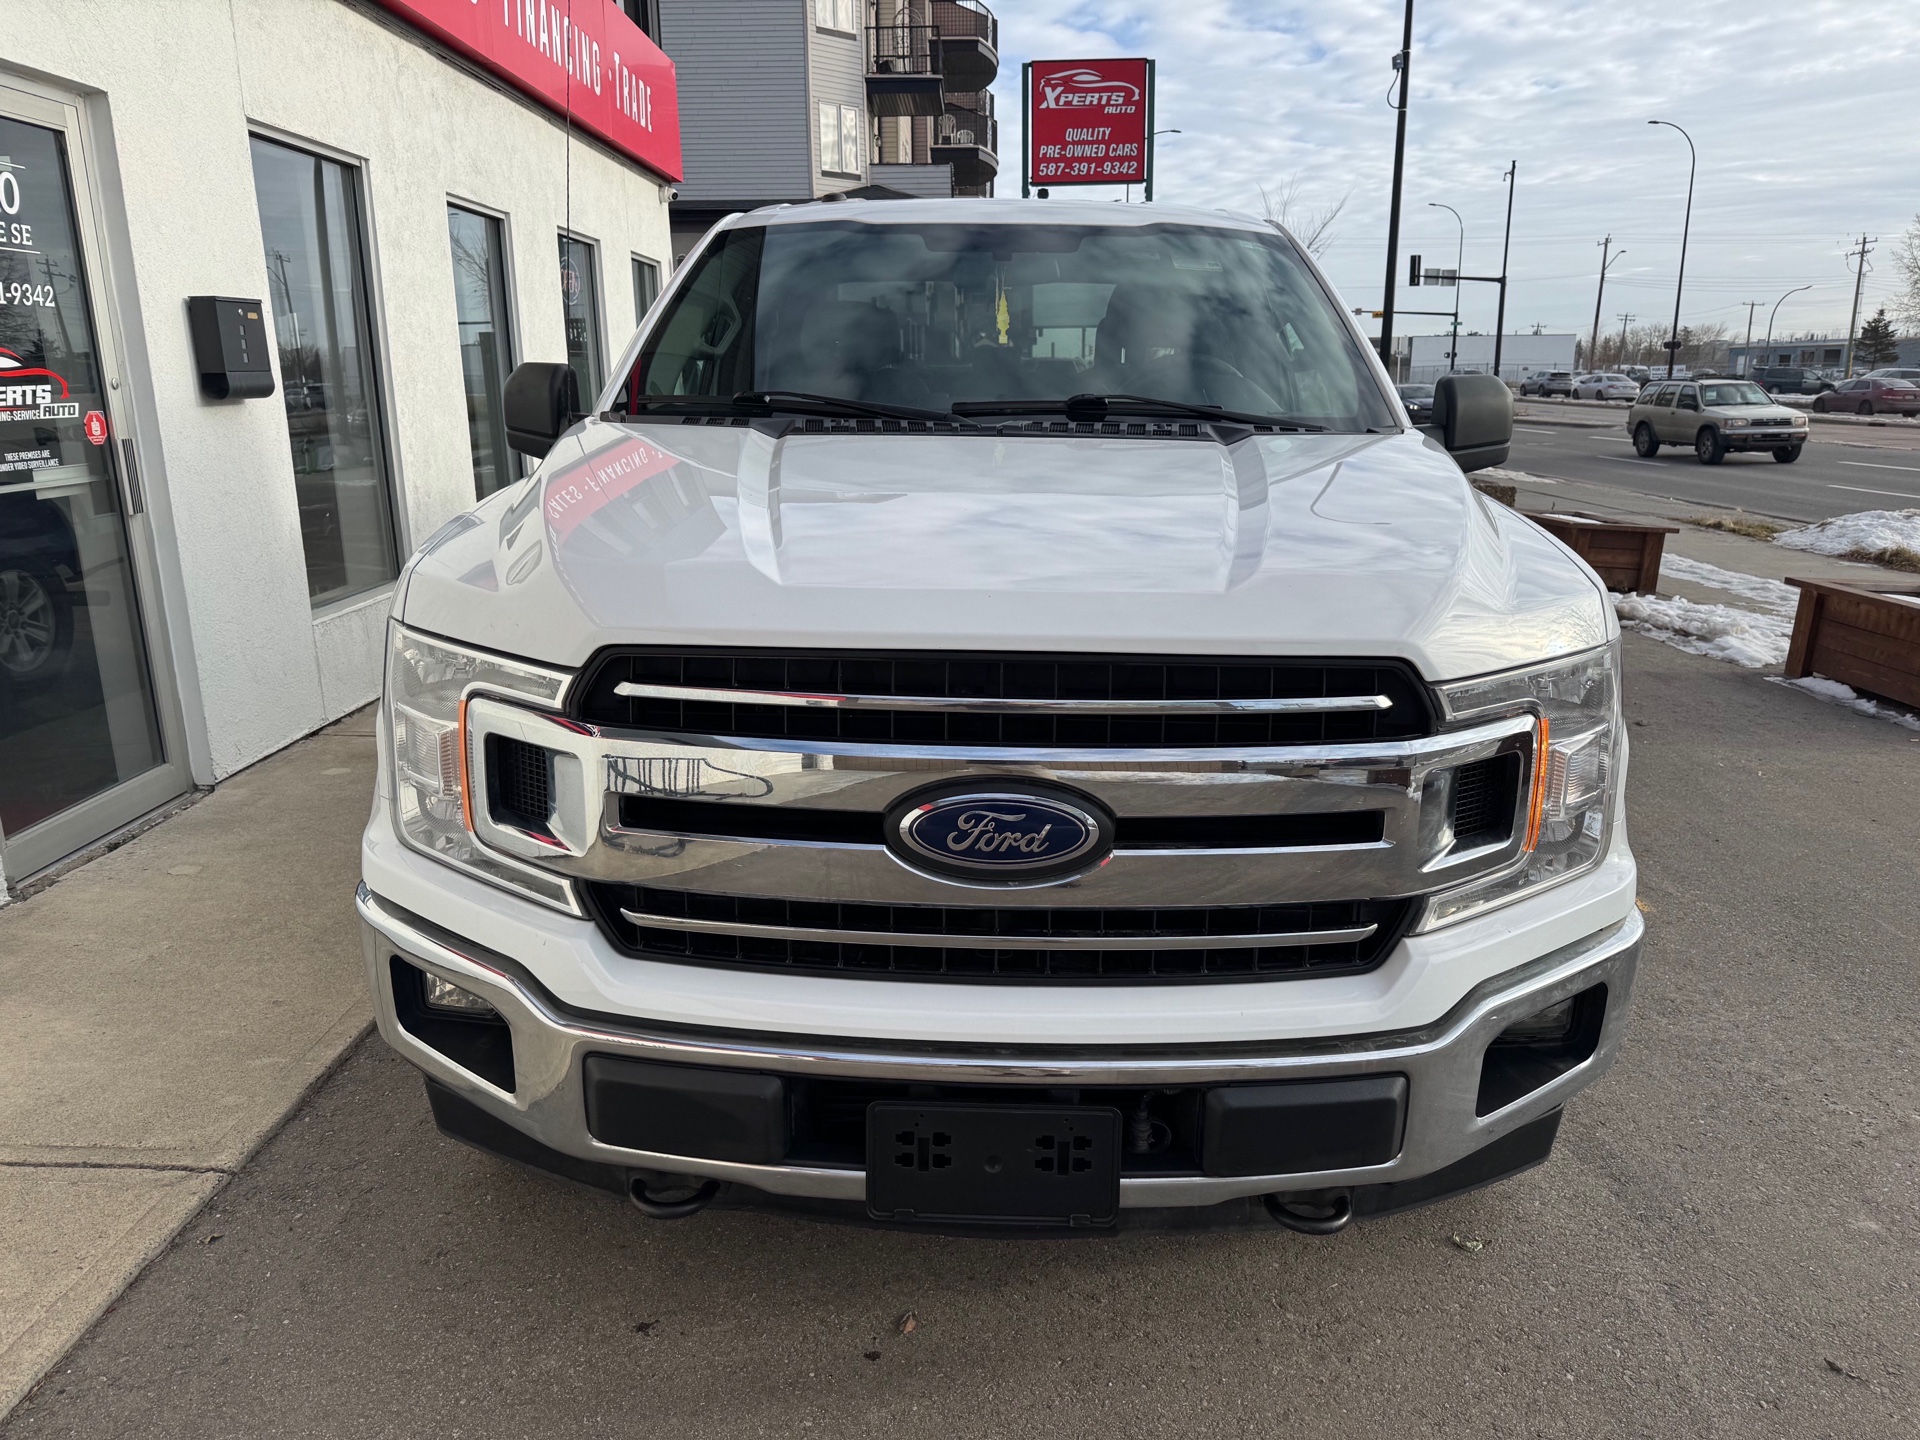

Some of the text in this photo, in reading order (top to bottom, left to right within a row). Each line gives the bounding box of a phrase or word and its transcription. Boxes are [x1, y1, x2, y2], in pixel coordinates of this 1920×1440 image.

[614, 51, 653, 133] TRADE
[1039, 86, 1125, 109] XPERTS
[1104, 105, 1136, 114] AUTO
[1065, 127, 1112, 142] QUALITY
[1039, 143, 1138, 158] PRE-OWNED CARS
[1038, 161, 1138, 176] 587-391-9342
[0, 171, 20, 215] 0
[11, 223, 33, 246] SE
[43, 404, 76, 417] AUTO
[41, 449, 50, 458] ARE
[946, 810, 1052, 853] Ford
